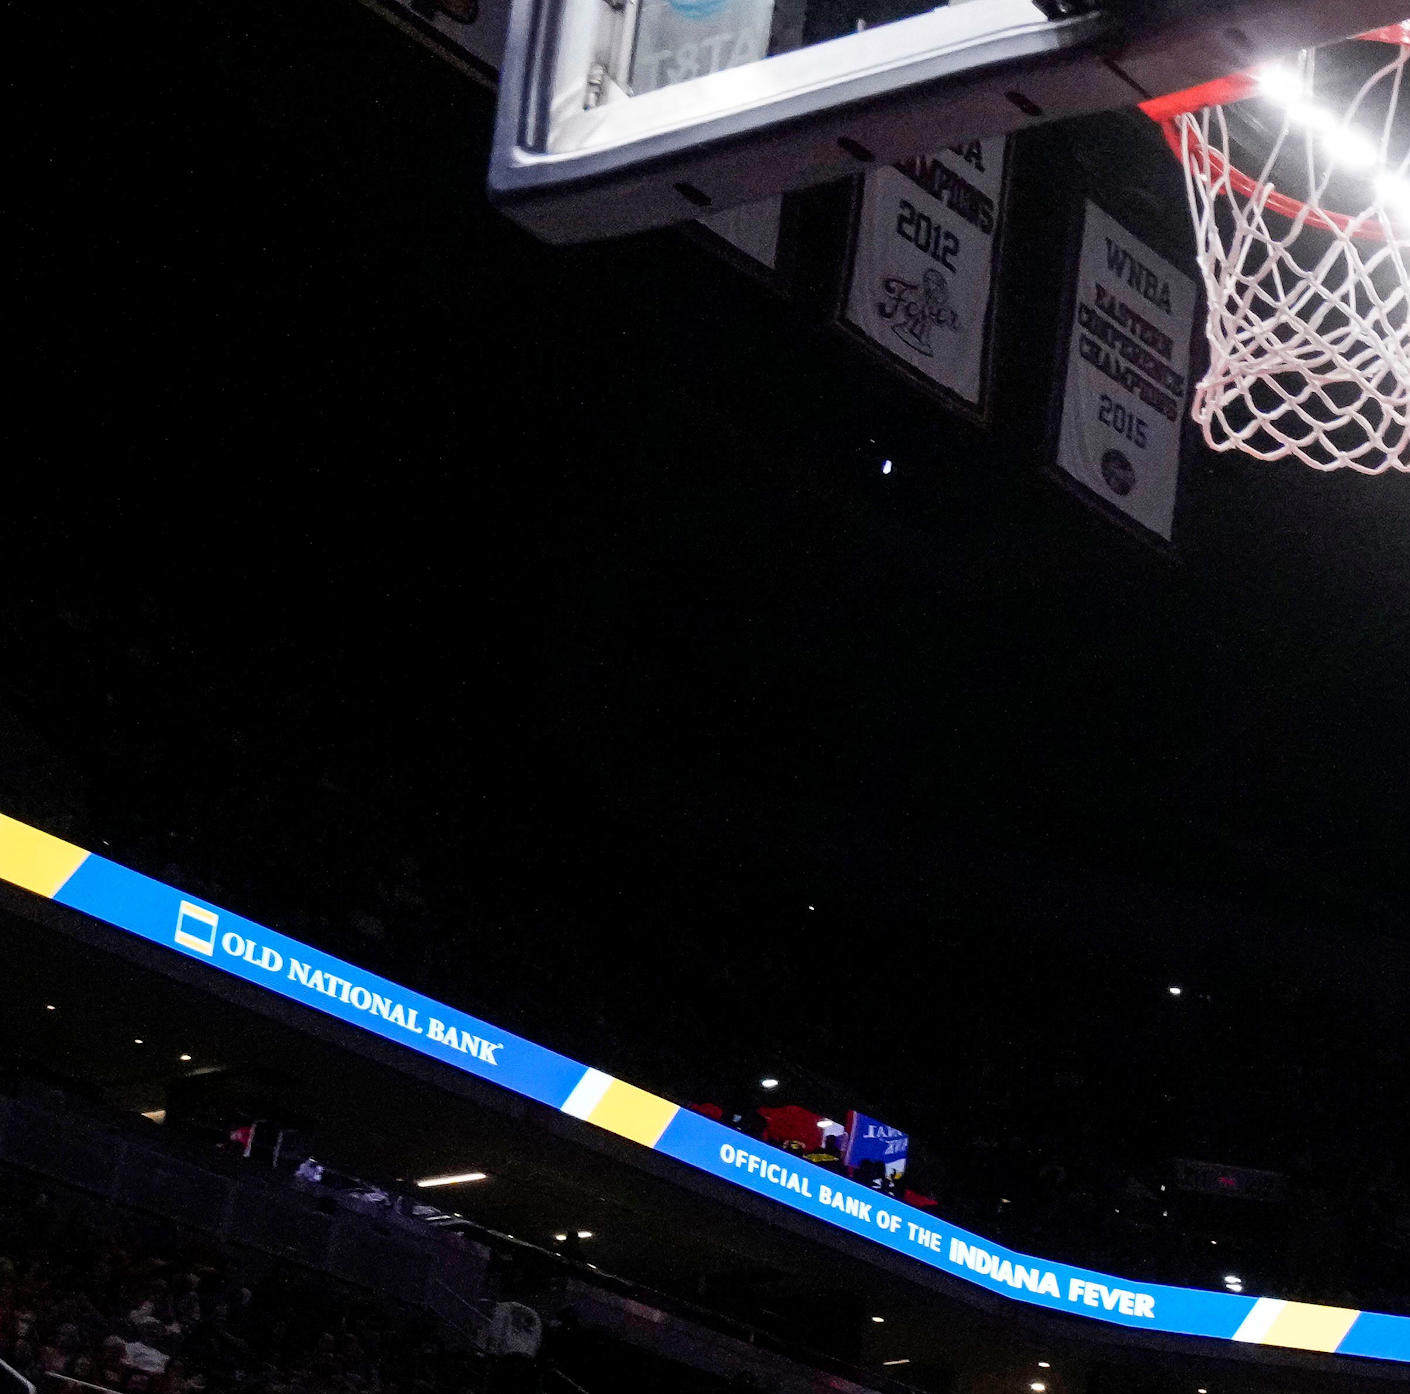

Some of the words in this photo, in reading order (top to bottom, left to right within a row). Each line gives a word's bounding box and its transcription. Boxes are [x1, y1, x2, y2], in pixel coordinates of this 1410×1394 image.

[897, 201, 961, 272] 2012
[1106, 236, 1172, 315] WNBA
[1095, 282, 1174, 360] EASTERN
[1098, 394, 1149, 449] 2015
[221, 932, 284, 973] OLD
[287, 959, 424, 1036] NATIONAL
[426, 1018, 504, 1066] BANK
[720, 1143, 814, 1199] OFFICIAL
[819, 1185, 872, 1224] BANK
[876, 1210, 902, 1234] OF
[907, 1221, 942, 1253] THE
[950, 1237, 1060, 1299] INDIANA
[1068, 1276, 1156, 1320] FEVER
